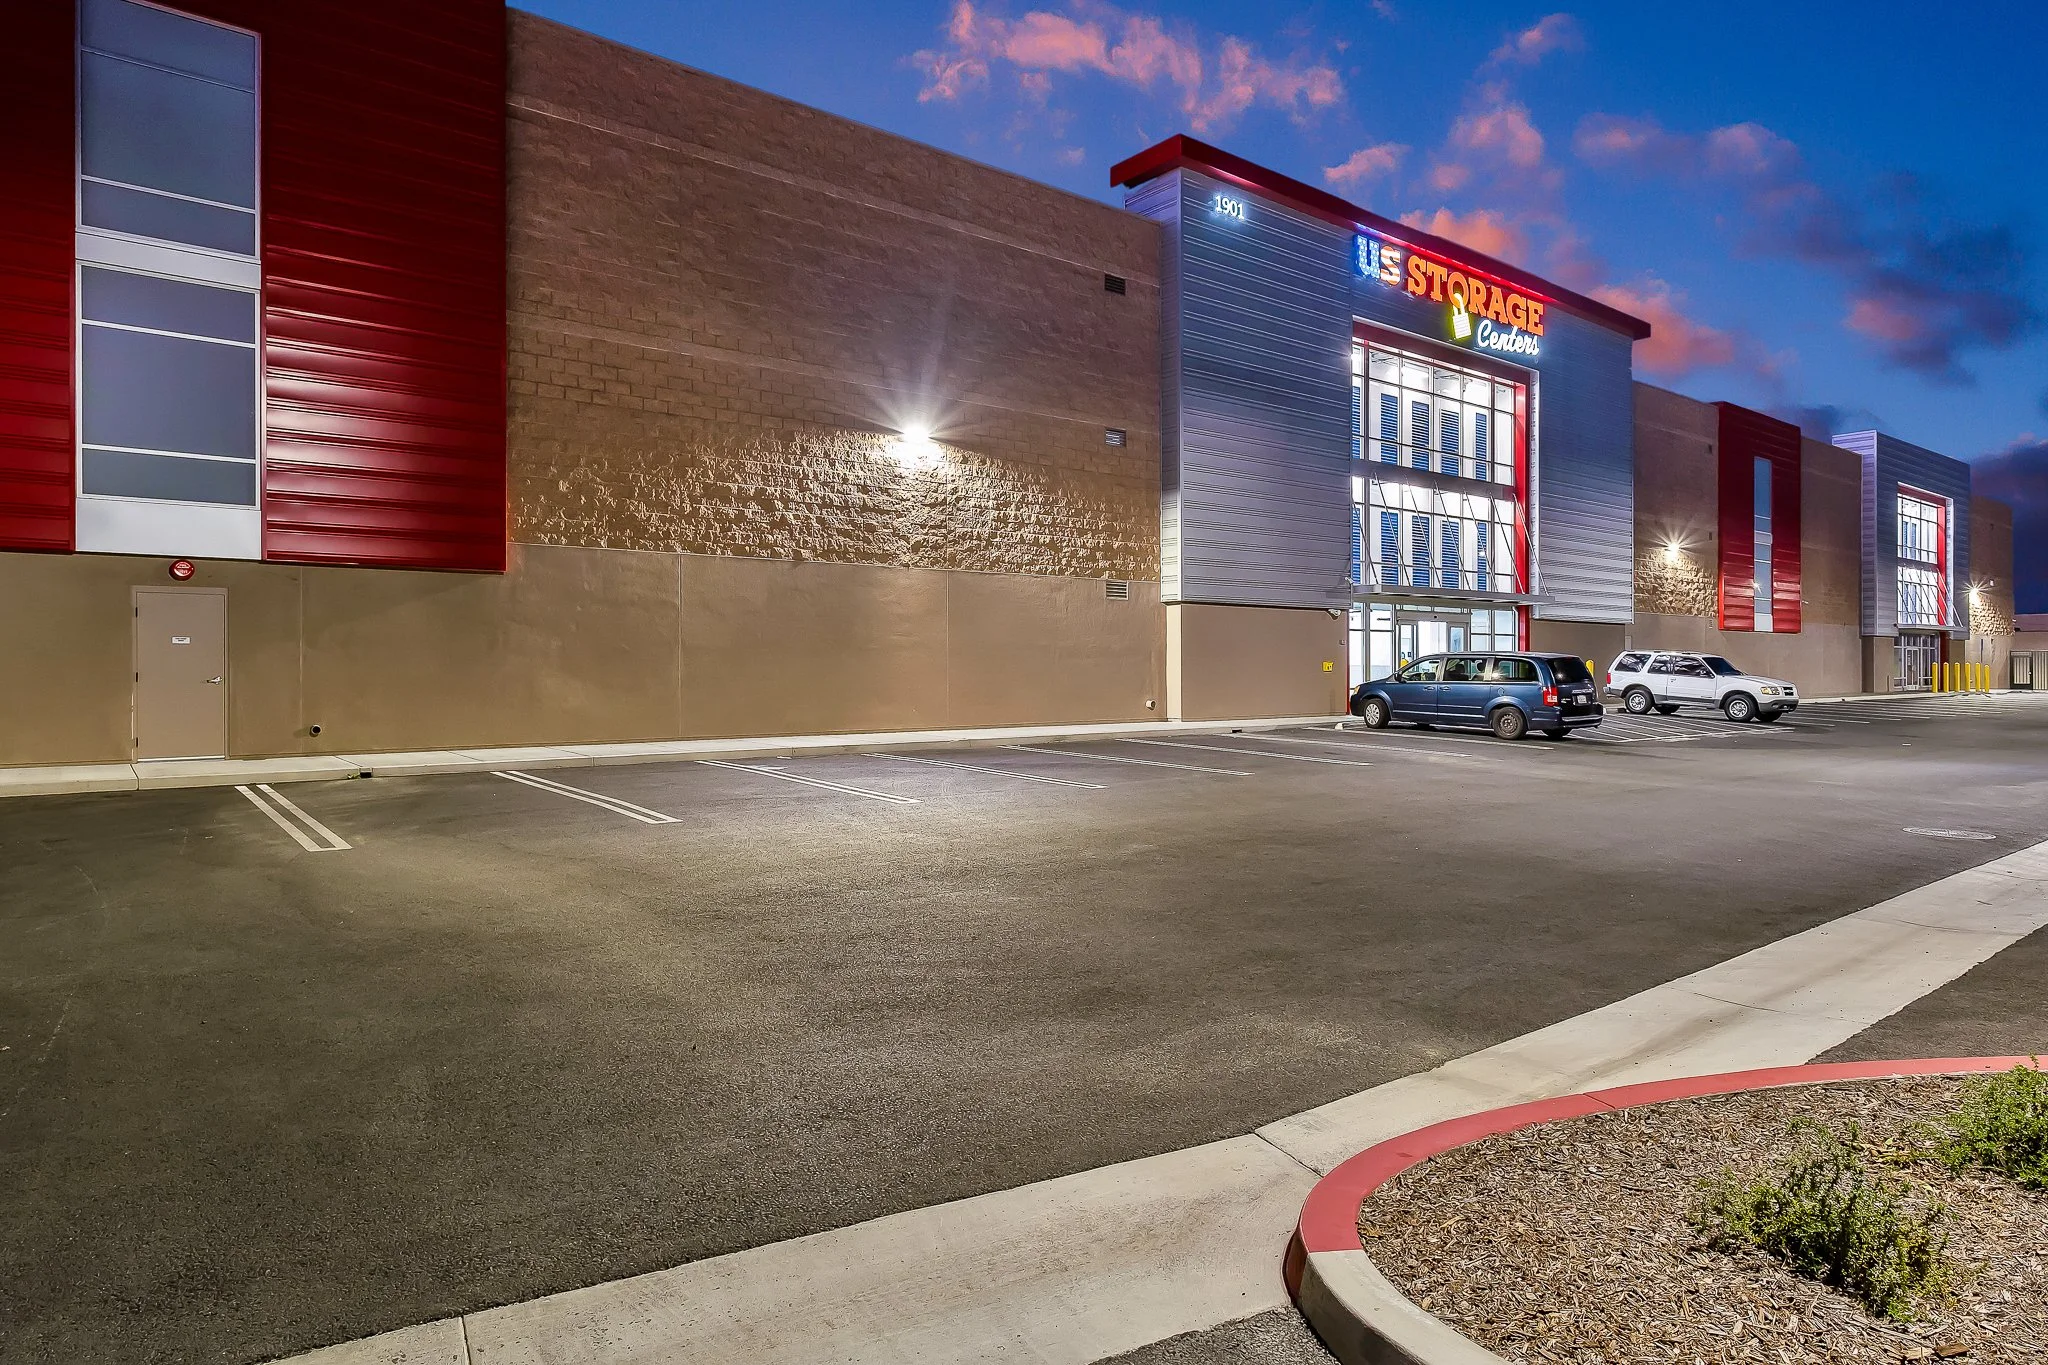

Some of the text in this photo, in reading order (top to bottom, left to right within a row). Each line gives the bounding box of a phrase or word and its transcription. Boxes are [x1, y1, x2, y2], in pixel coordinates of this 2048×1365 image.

[1215, 195, 1244, 220] 1901
[1356, 235, 1544, 336] US STORAGE
[1477, 319, 1540, 356] Centers
